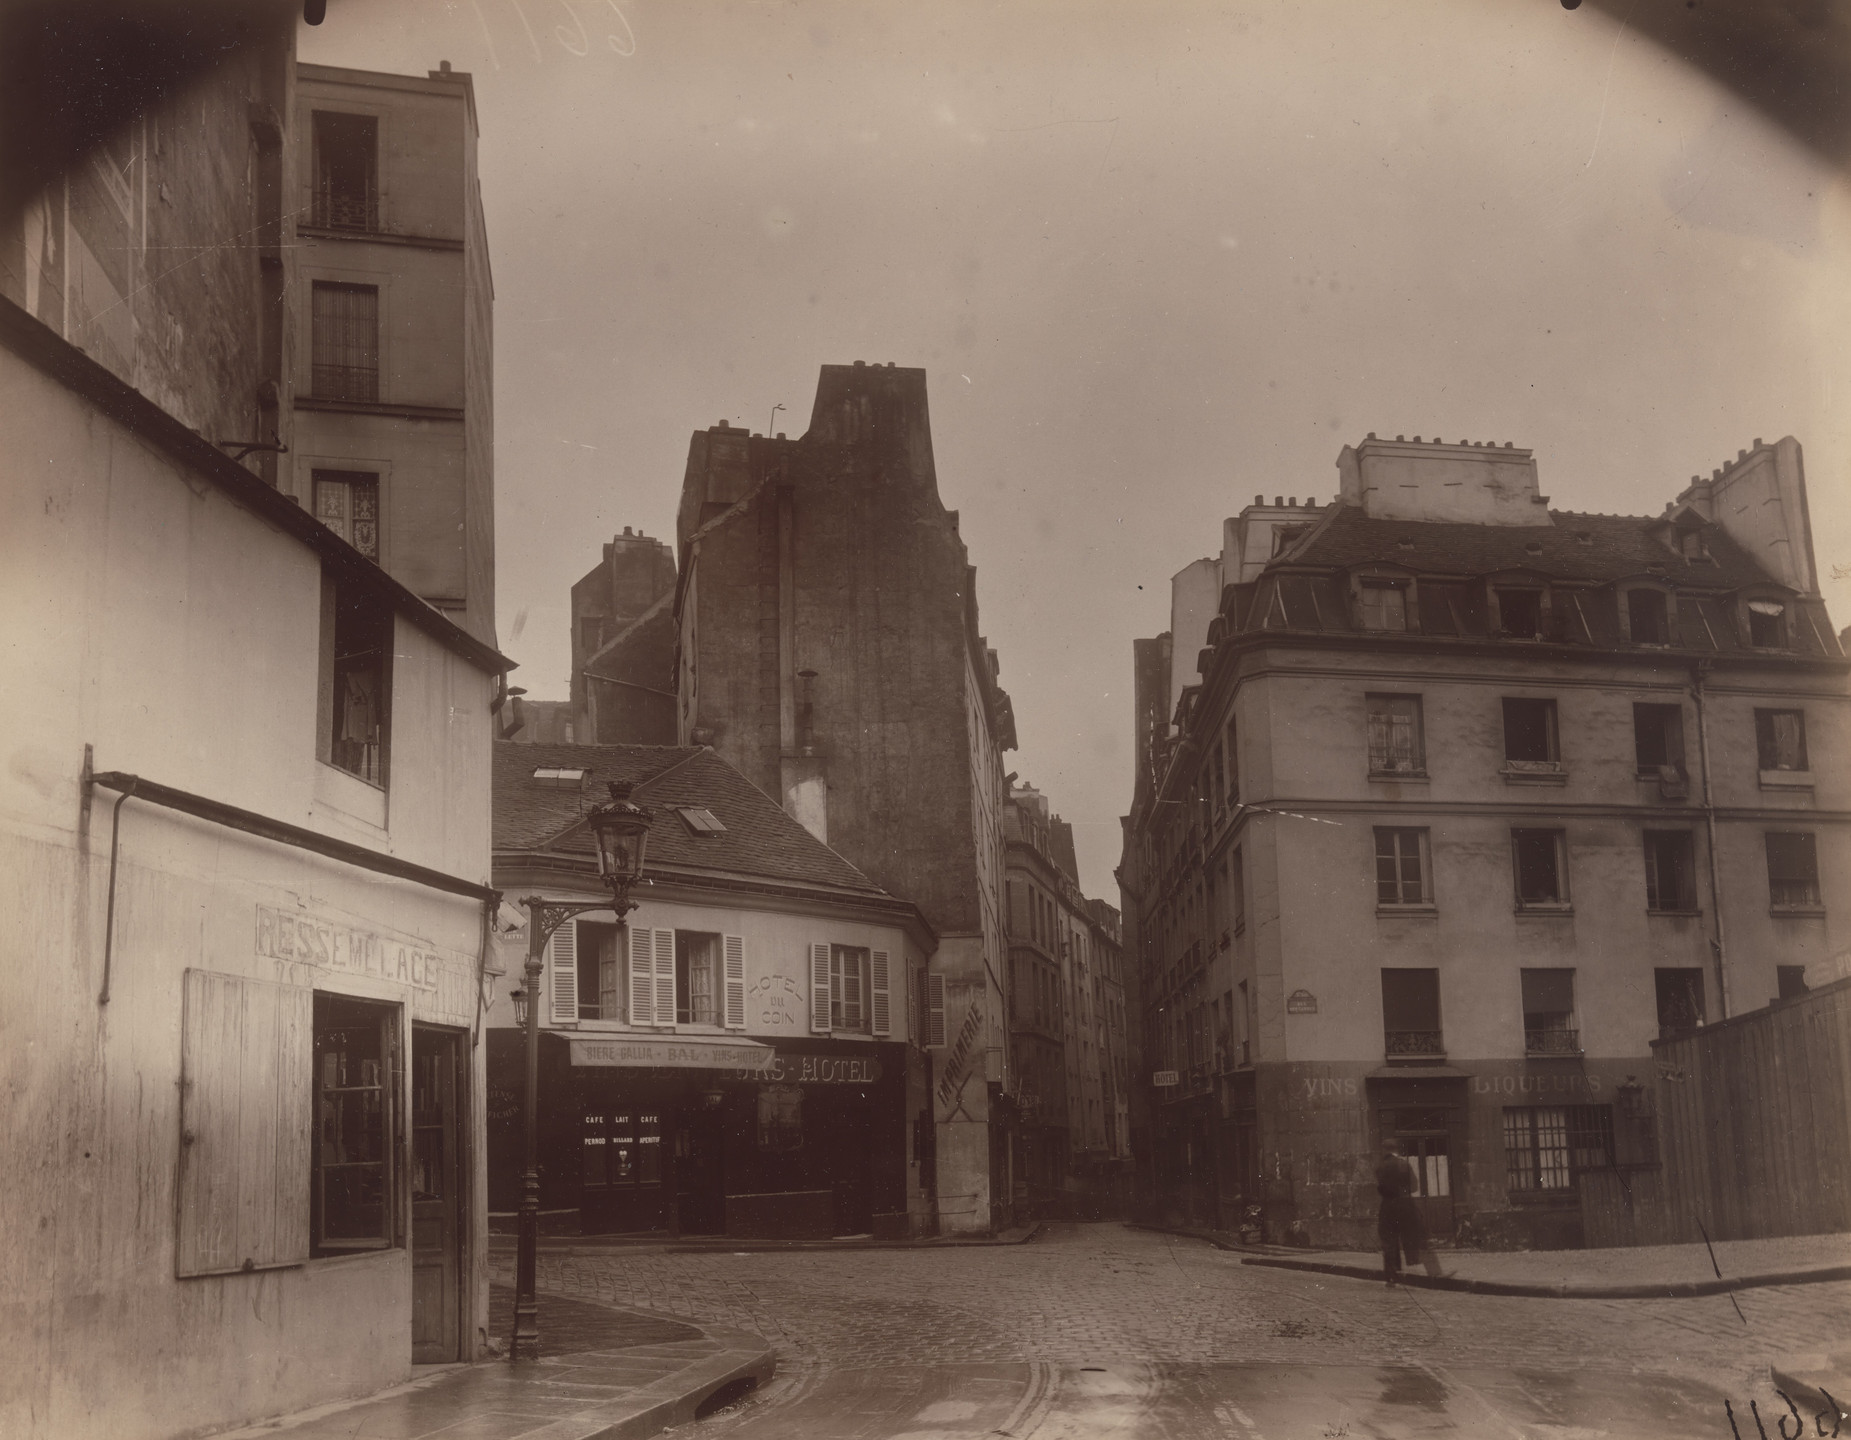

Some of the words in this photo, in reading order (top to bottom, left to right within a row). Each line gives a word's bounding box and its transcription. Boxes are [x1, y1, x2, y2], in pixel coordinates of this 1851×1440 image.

[747, 975, 803, 1002] HOTEL
[762, 1011, 795, 1025] COIN
[586, 1046, 615, 1060] BIERE
[621, 1046, 653, 1060] GALLIA
[667, 1048, 699, 1061] BAL
[712, 1050, 732, 1062] VINS
[737, 1051, 763, 1064] HOTEL
[937, 1002, 984, 1107] IMPRIMERIE
[799, 1057, 875, 1083] HOTEL
[1303, 1077, 1358, 1098] VINS
[1474, 1073, 1602, 1095] LIQUEURS
[585, 1116, 604, 1124] CAFE
[584, 1137, 606, 1146] PERNOD
